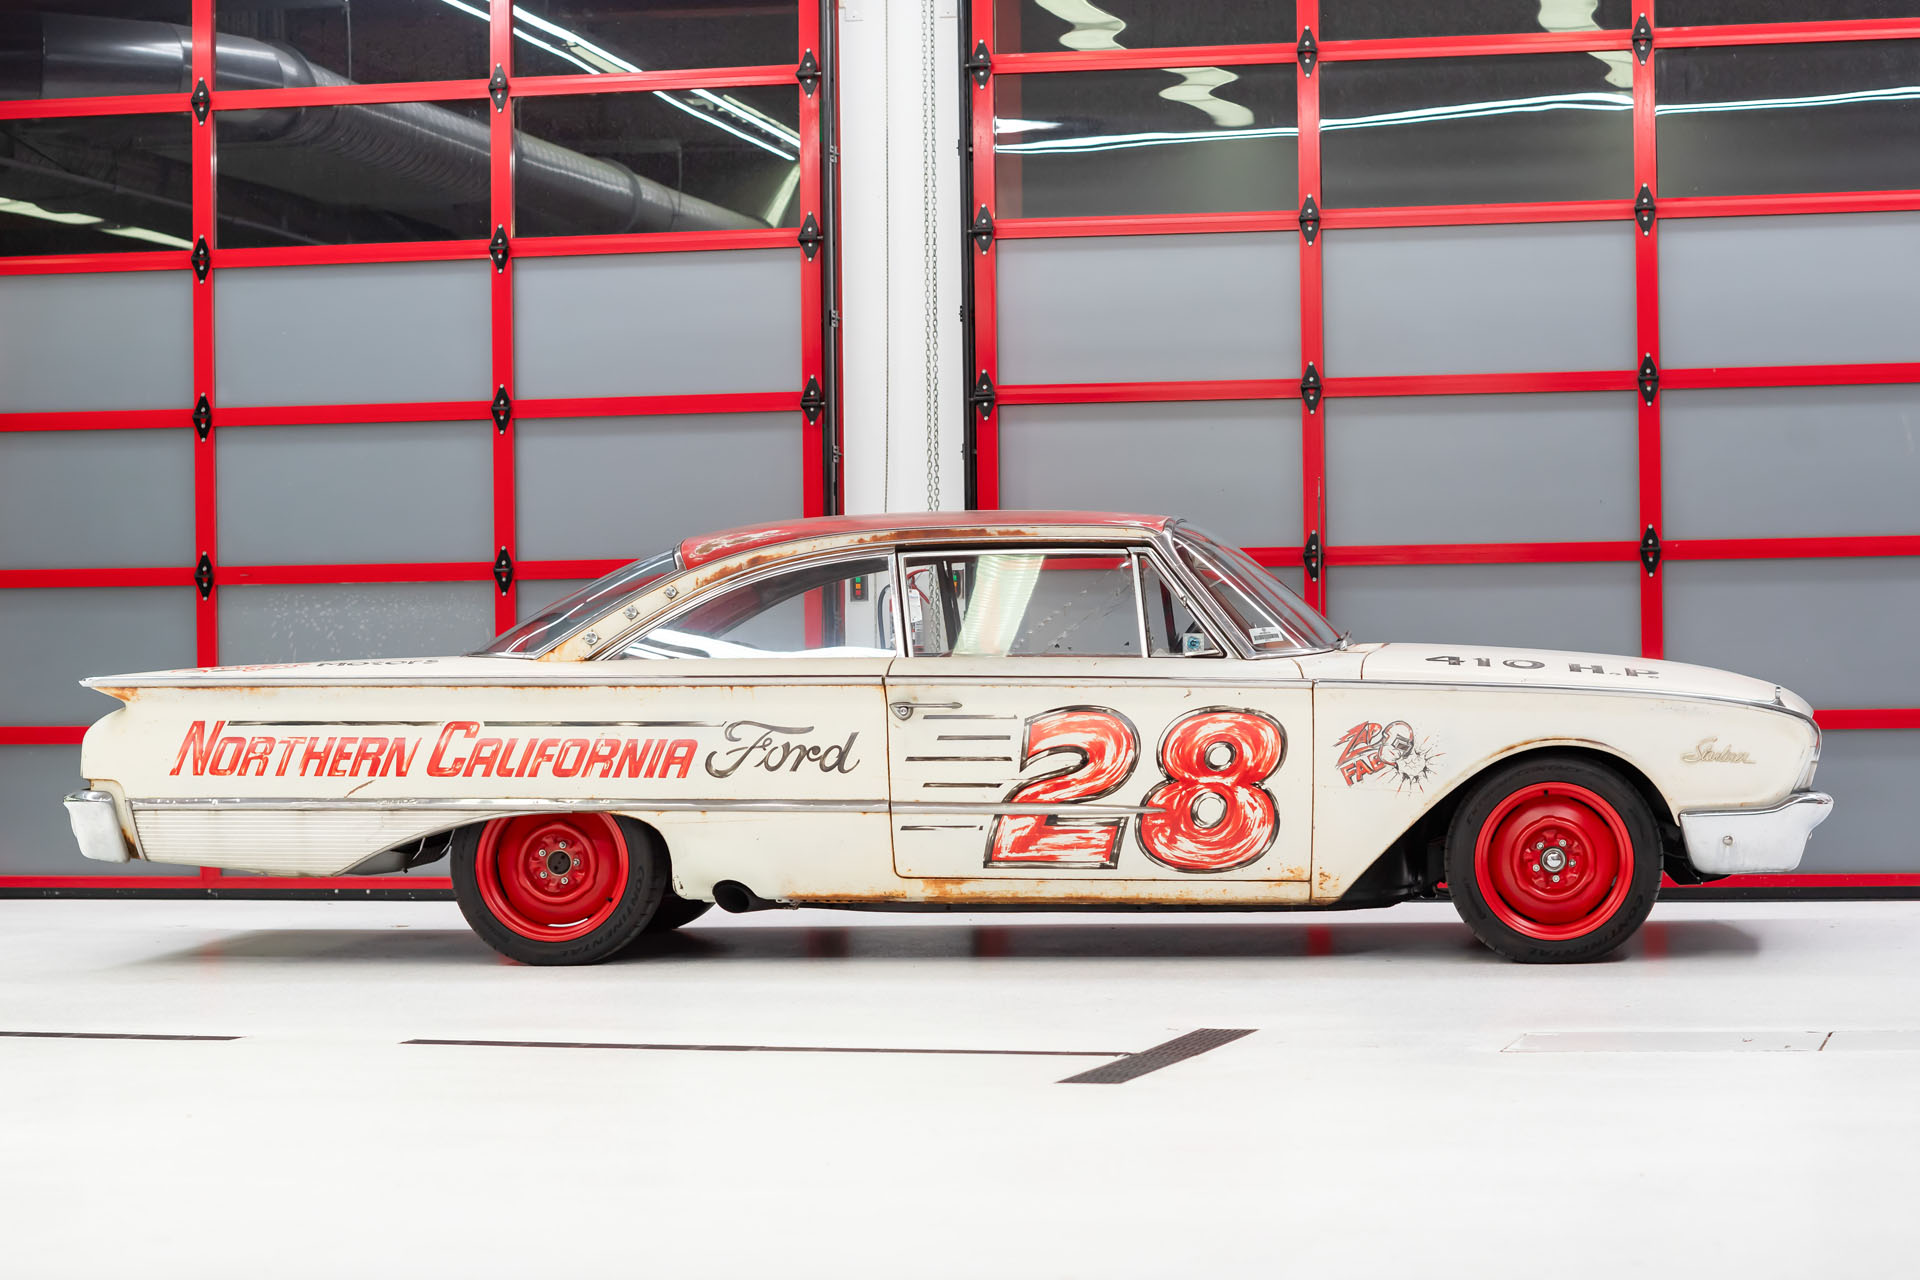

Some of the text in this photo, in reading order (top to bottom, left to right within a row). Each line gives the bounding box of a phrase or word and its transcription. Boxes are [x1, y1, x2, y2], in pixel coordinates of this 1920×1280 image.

[1425, 655, 1545, 669] 410
[169, 720, 860, 778] NORTHERN CALIFORNIA Ford
[1333, 721, 1382, 768] ZAP
[1341, 752, 1386, 786] FAB
[983, 704, 1288, 874] 28
[562, 864, 645, 958] CONTINENTAL
